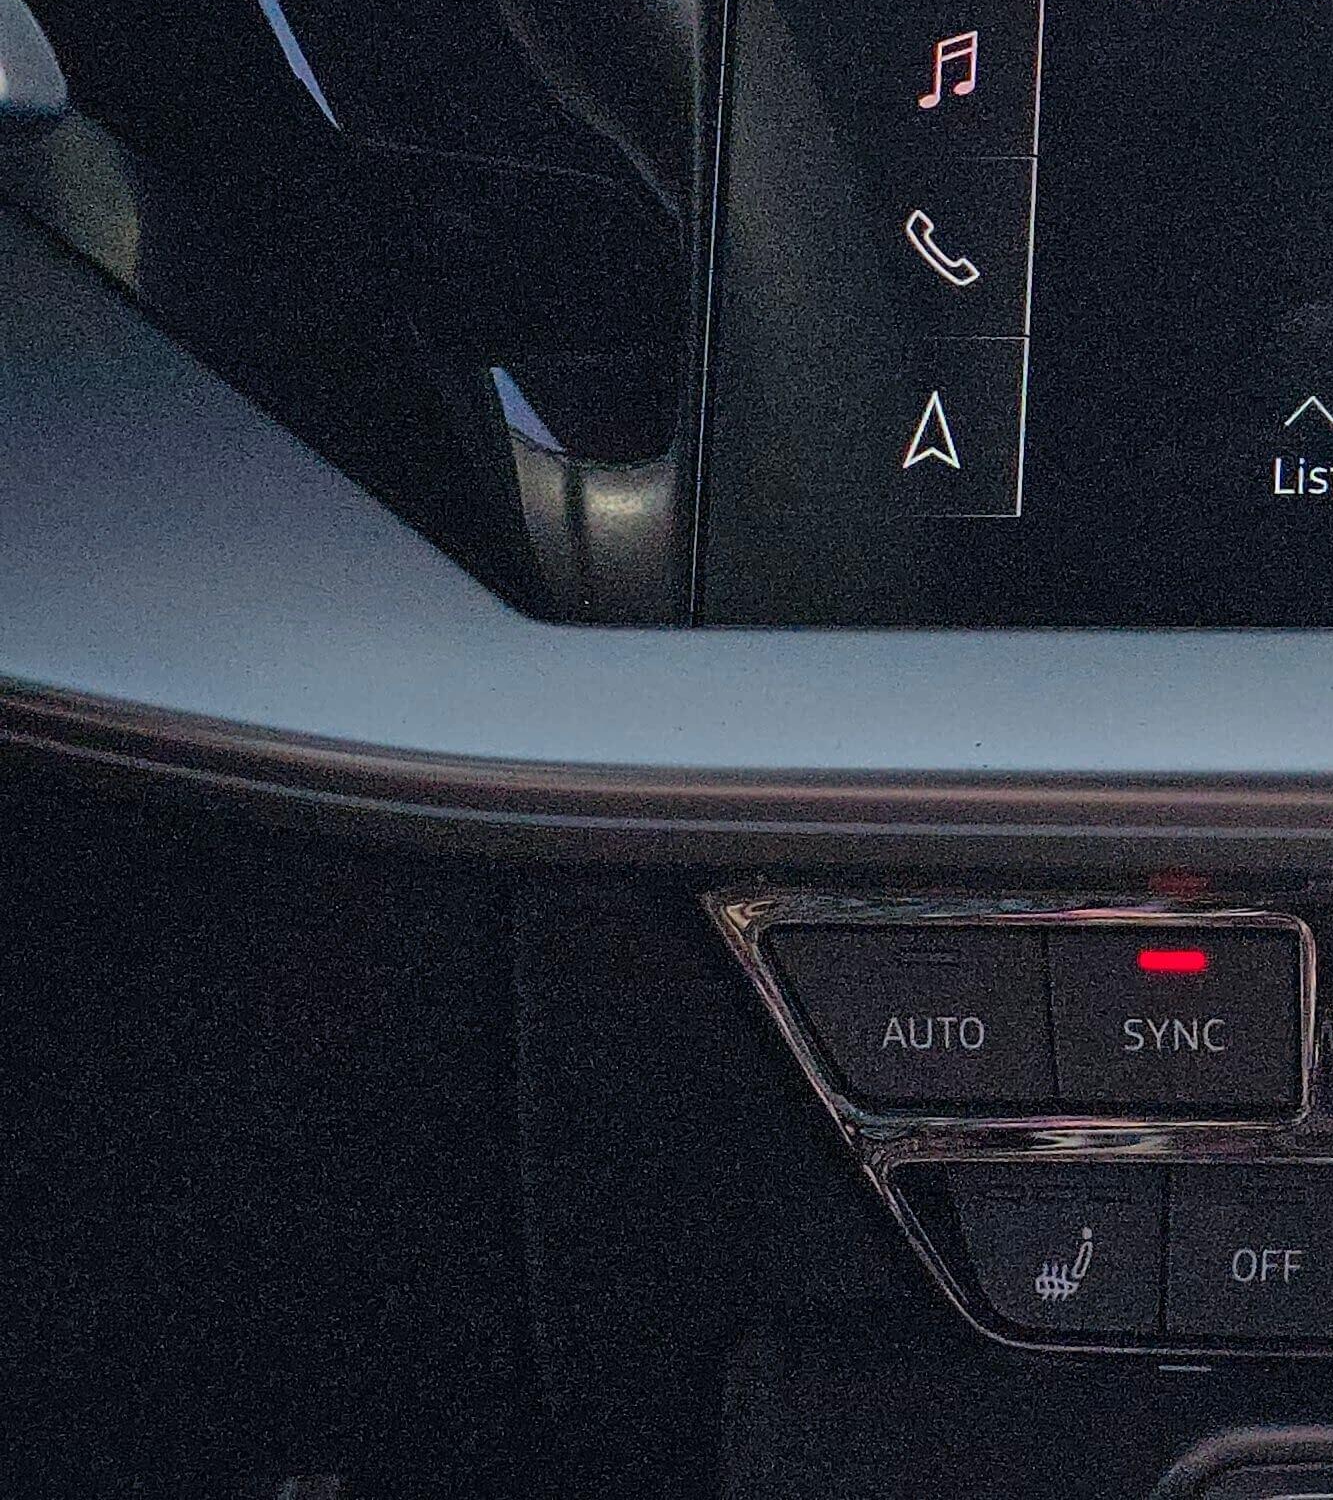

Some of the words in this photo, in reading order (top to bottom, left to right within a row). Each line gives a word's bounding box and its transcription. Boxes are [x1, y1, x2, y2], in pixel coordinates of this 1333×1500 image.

[882, 1016, 985, 1052] AUTO
[1122, 1017, 1227, 1053] SYNC
[1231, 1249, 1303, 1283] OFF
